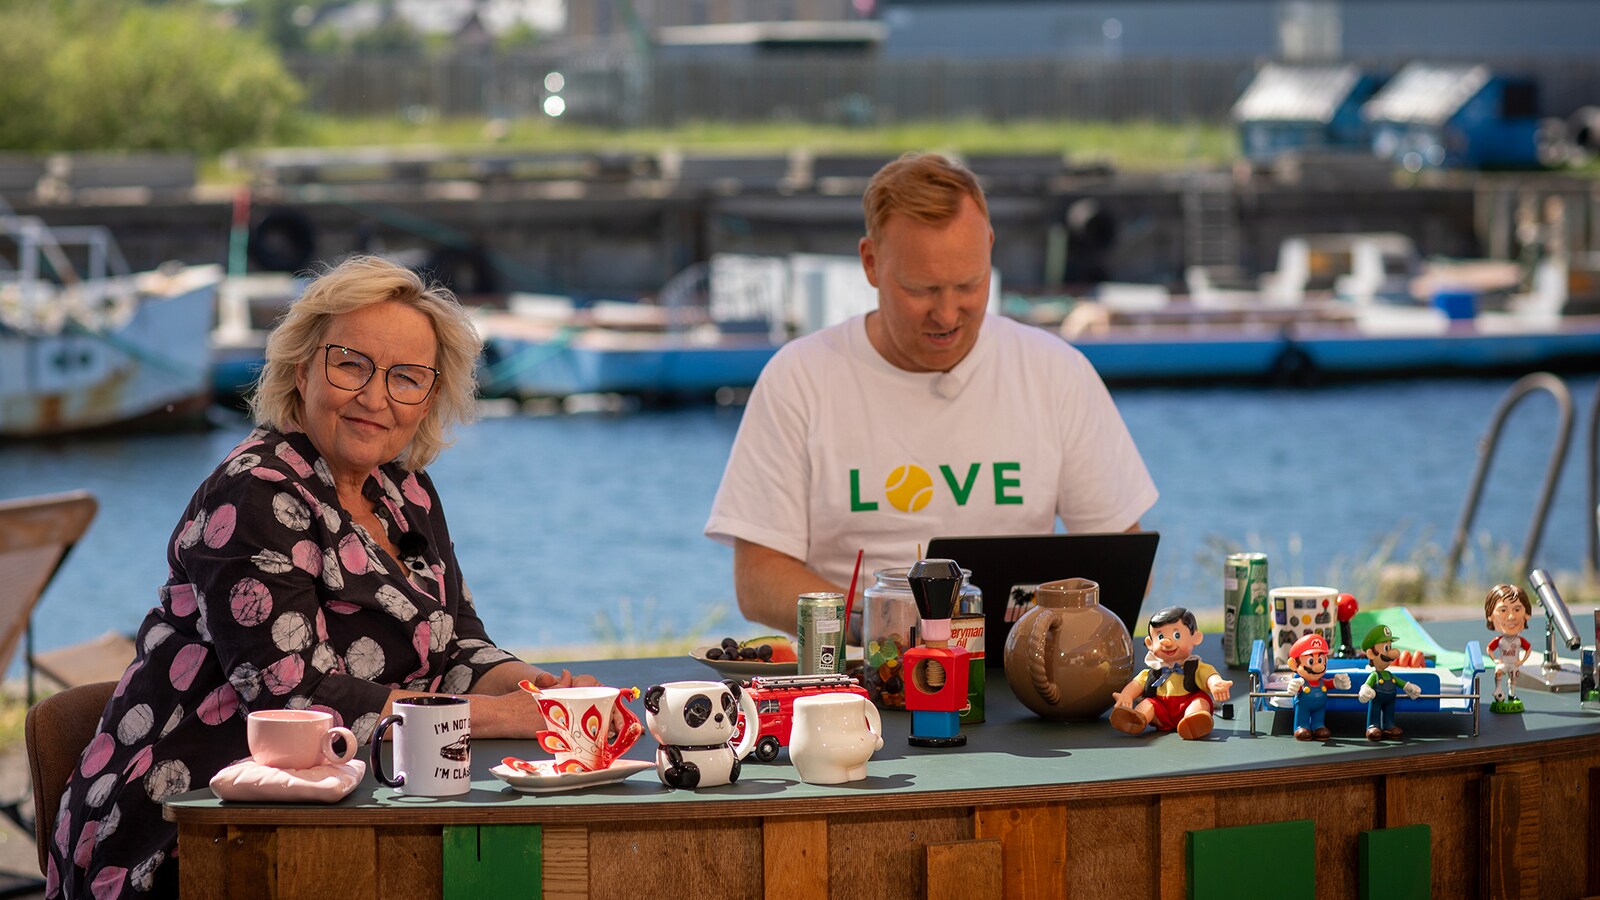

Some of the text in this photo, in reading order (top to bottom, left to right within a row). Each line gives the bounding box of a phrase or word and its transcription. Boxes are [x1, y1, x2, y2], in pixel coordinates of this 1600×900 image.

[849, 462, 1024, 513] LOVE
[951, 627, 984, 640] eryman
[434, 721, 449, 735] I'M
[452, 718, 467, 731] NOT
[434, 767, 450, 779] I'M
